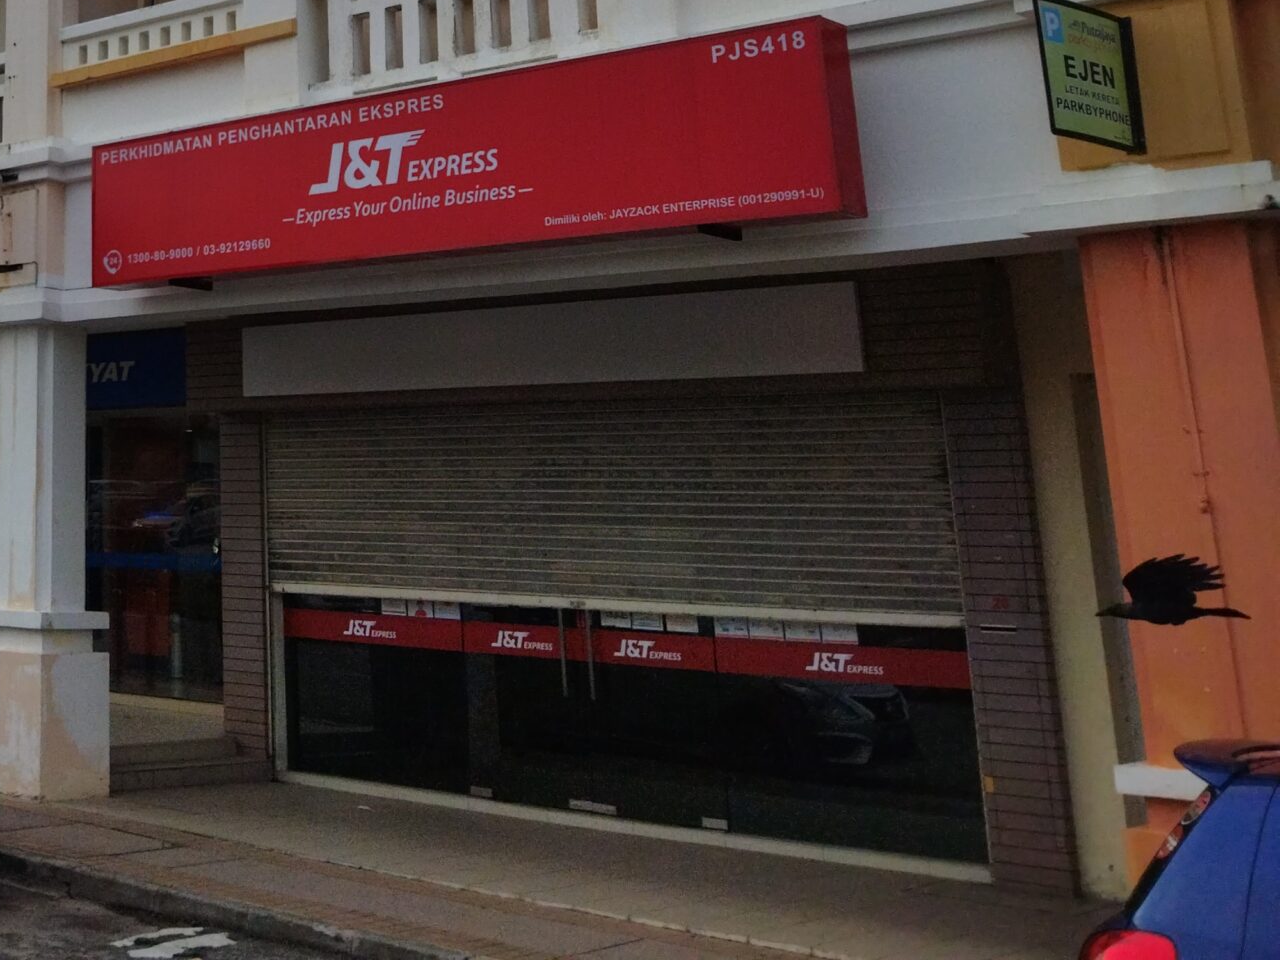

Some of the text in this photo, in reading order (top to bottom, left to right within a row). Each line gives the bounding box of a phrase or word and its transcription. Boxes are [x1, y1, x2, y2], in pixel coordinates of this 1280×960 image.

[711, 31, 806, 64] PJS418
[1063, 54, 1115, 89] EJEN
[1065, 85, 1120, 106] LETAK KERETA
[1056, 97, 1131, 126] PARKBYPHONE
[100, 93, 445, 166] PERKHIDMATAN PENGHANTARAN EKSPRES
[308, 129, 498, 196] J&T EXPRESS
[295, 184, 516, 228] Express Your Online Business
[544, 186, 825, 227] Dimiliki oleh: JAYZACK ENTERPRISE (001290991-U)
[127, 246, 194, 264] 1300-80-9000
[203, 238, 271, 256] 03-92129660
[87, 361, 135, 383] YAT
[343, 619, 397, 640] J&T EXPRESS
[491, 630, 553, 651] J&T EXPRESS
[614, 639, 682, 661] J&T EXPRESS
[805, 652, 884, 675] J&T EXPRESS
